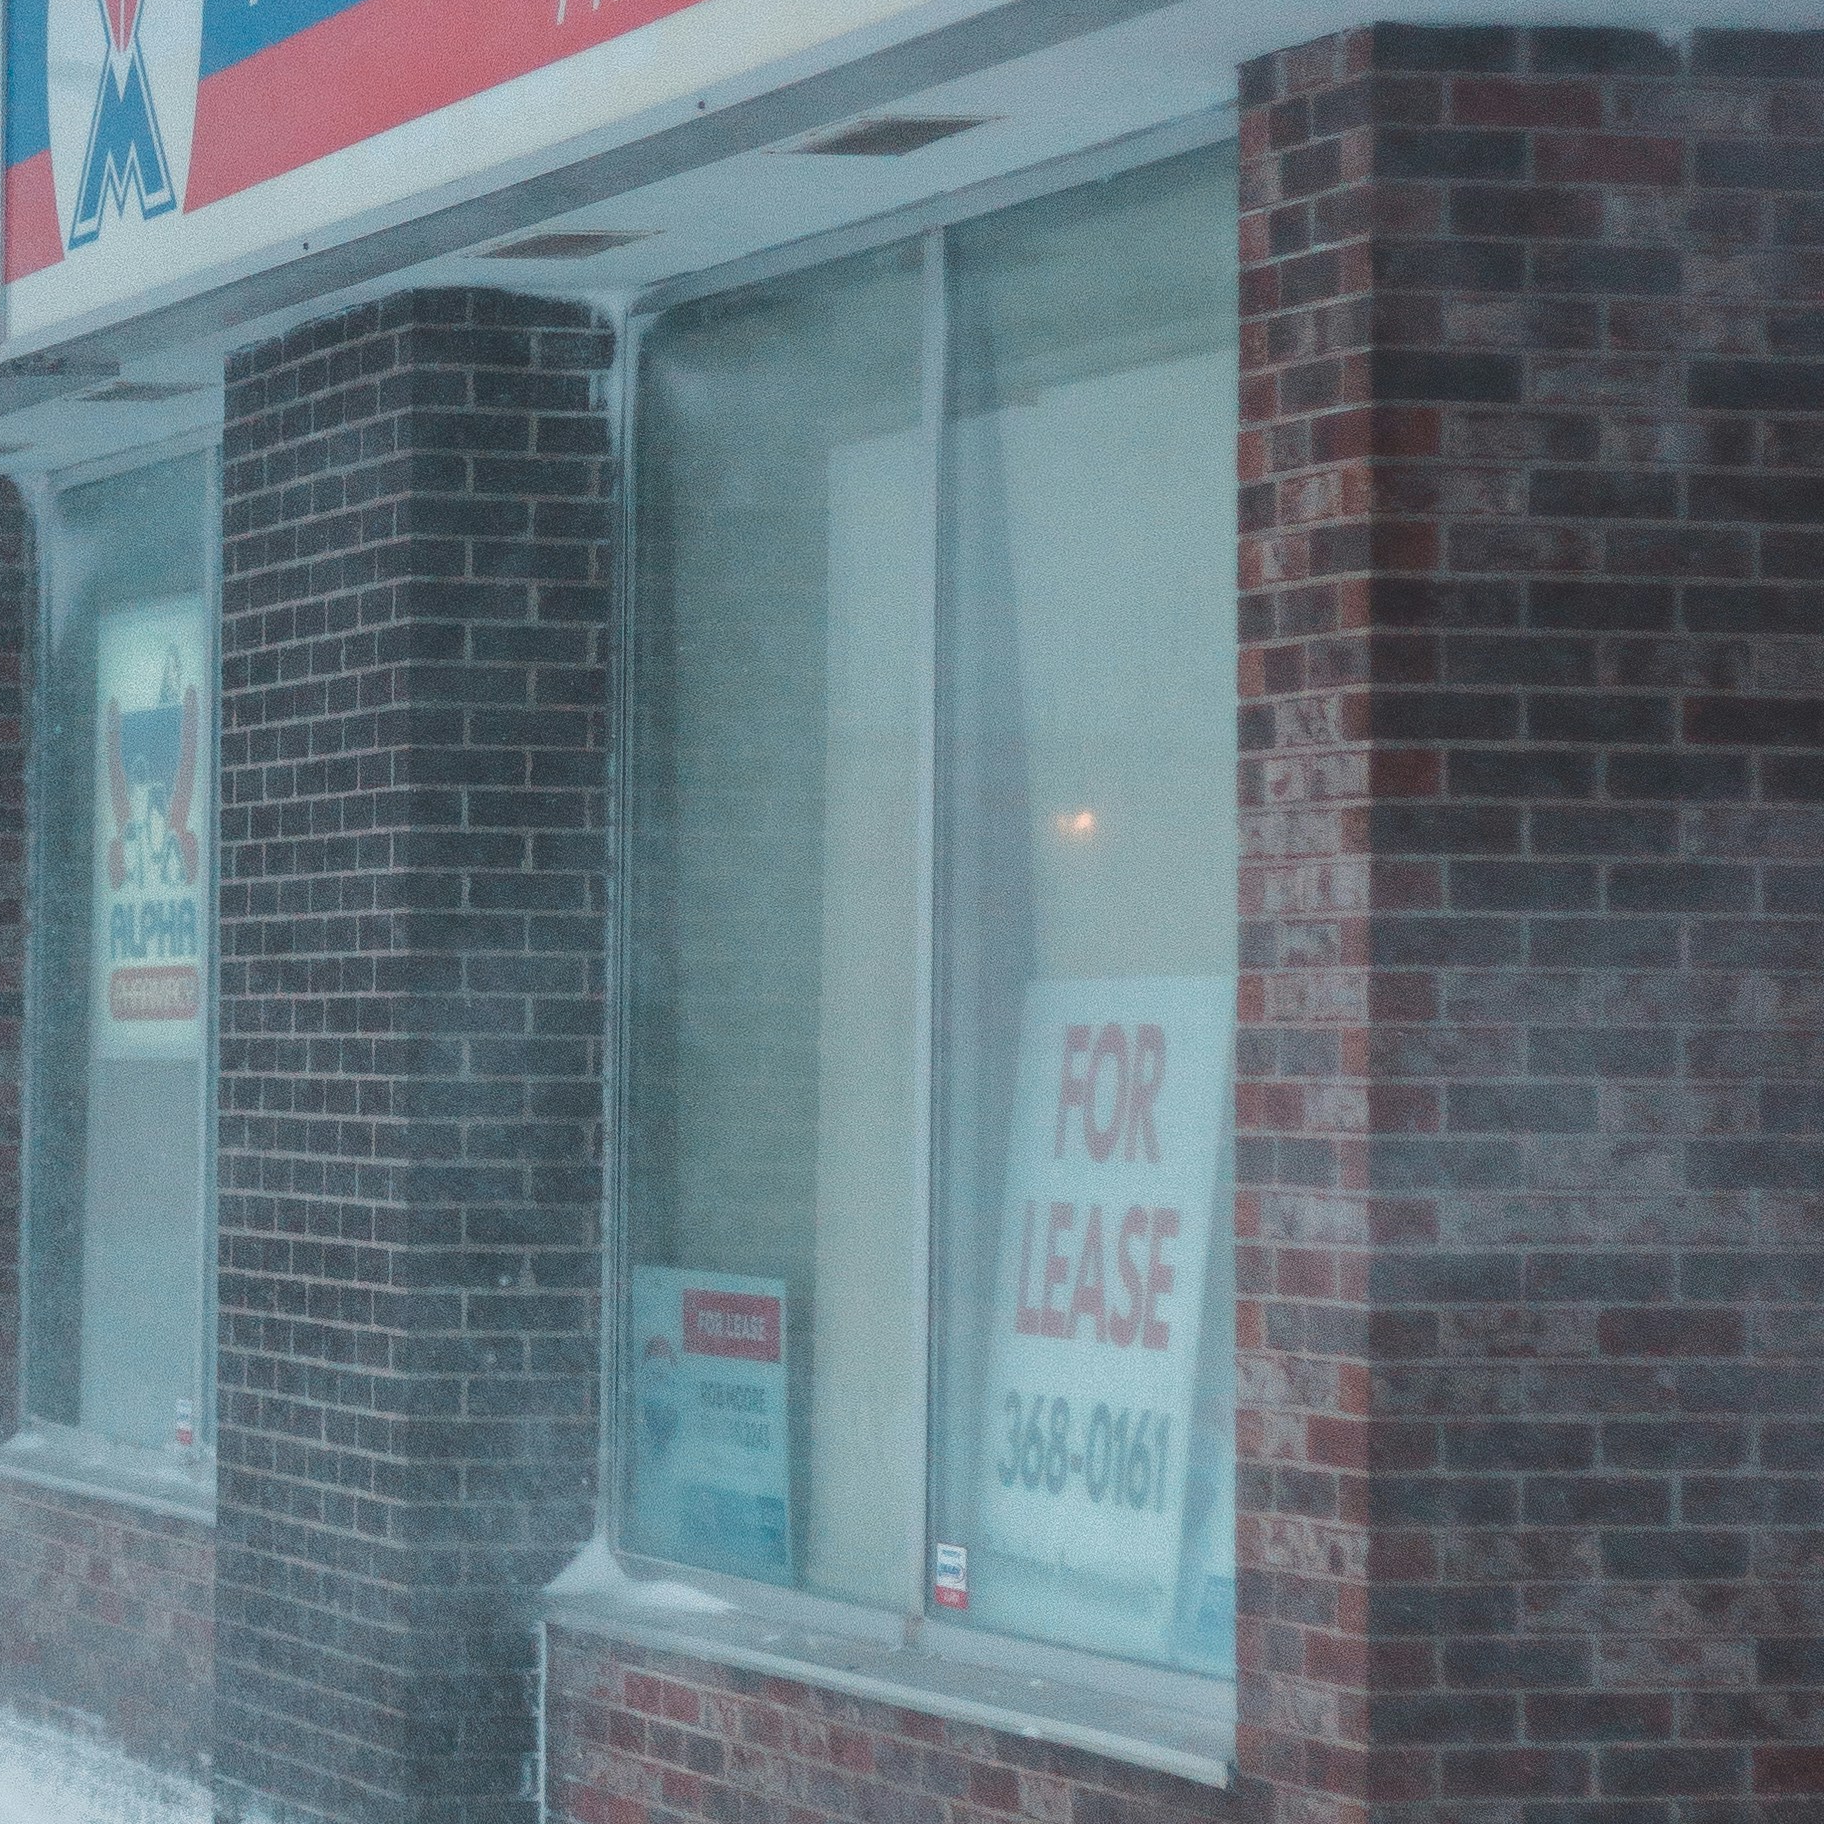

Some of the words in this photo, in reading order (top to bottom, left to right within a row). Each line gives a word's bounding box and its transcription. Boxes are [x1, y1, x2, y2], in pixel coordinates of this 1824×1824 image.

[110, 898, 196, 958] ALPHA
[1054, 1022, 1165, 1164] FOR
[1015, 1199, 1180, 1350] LEASE
[997, 1390, 1171, 1513] 368-0161
